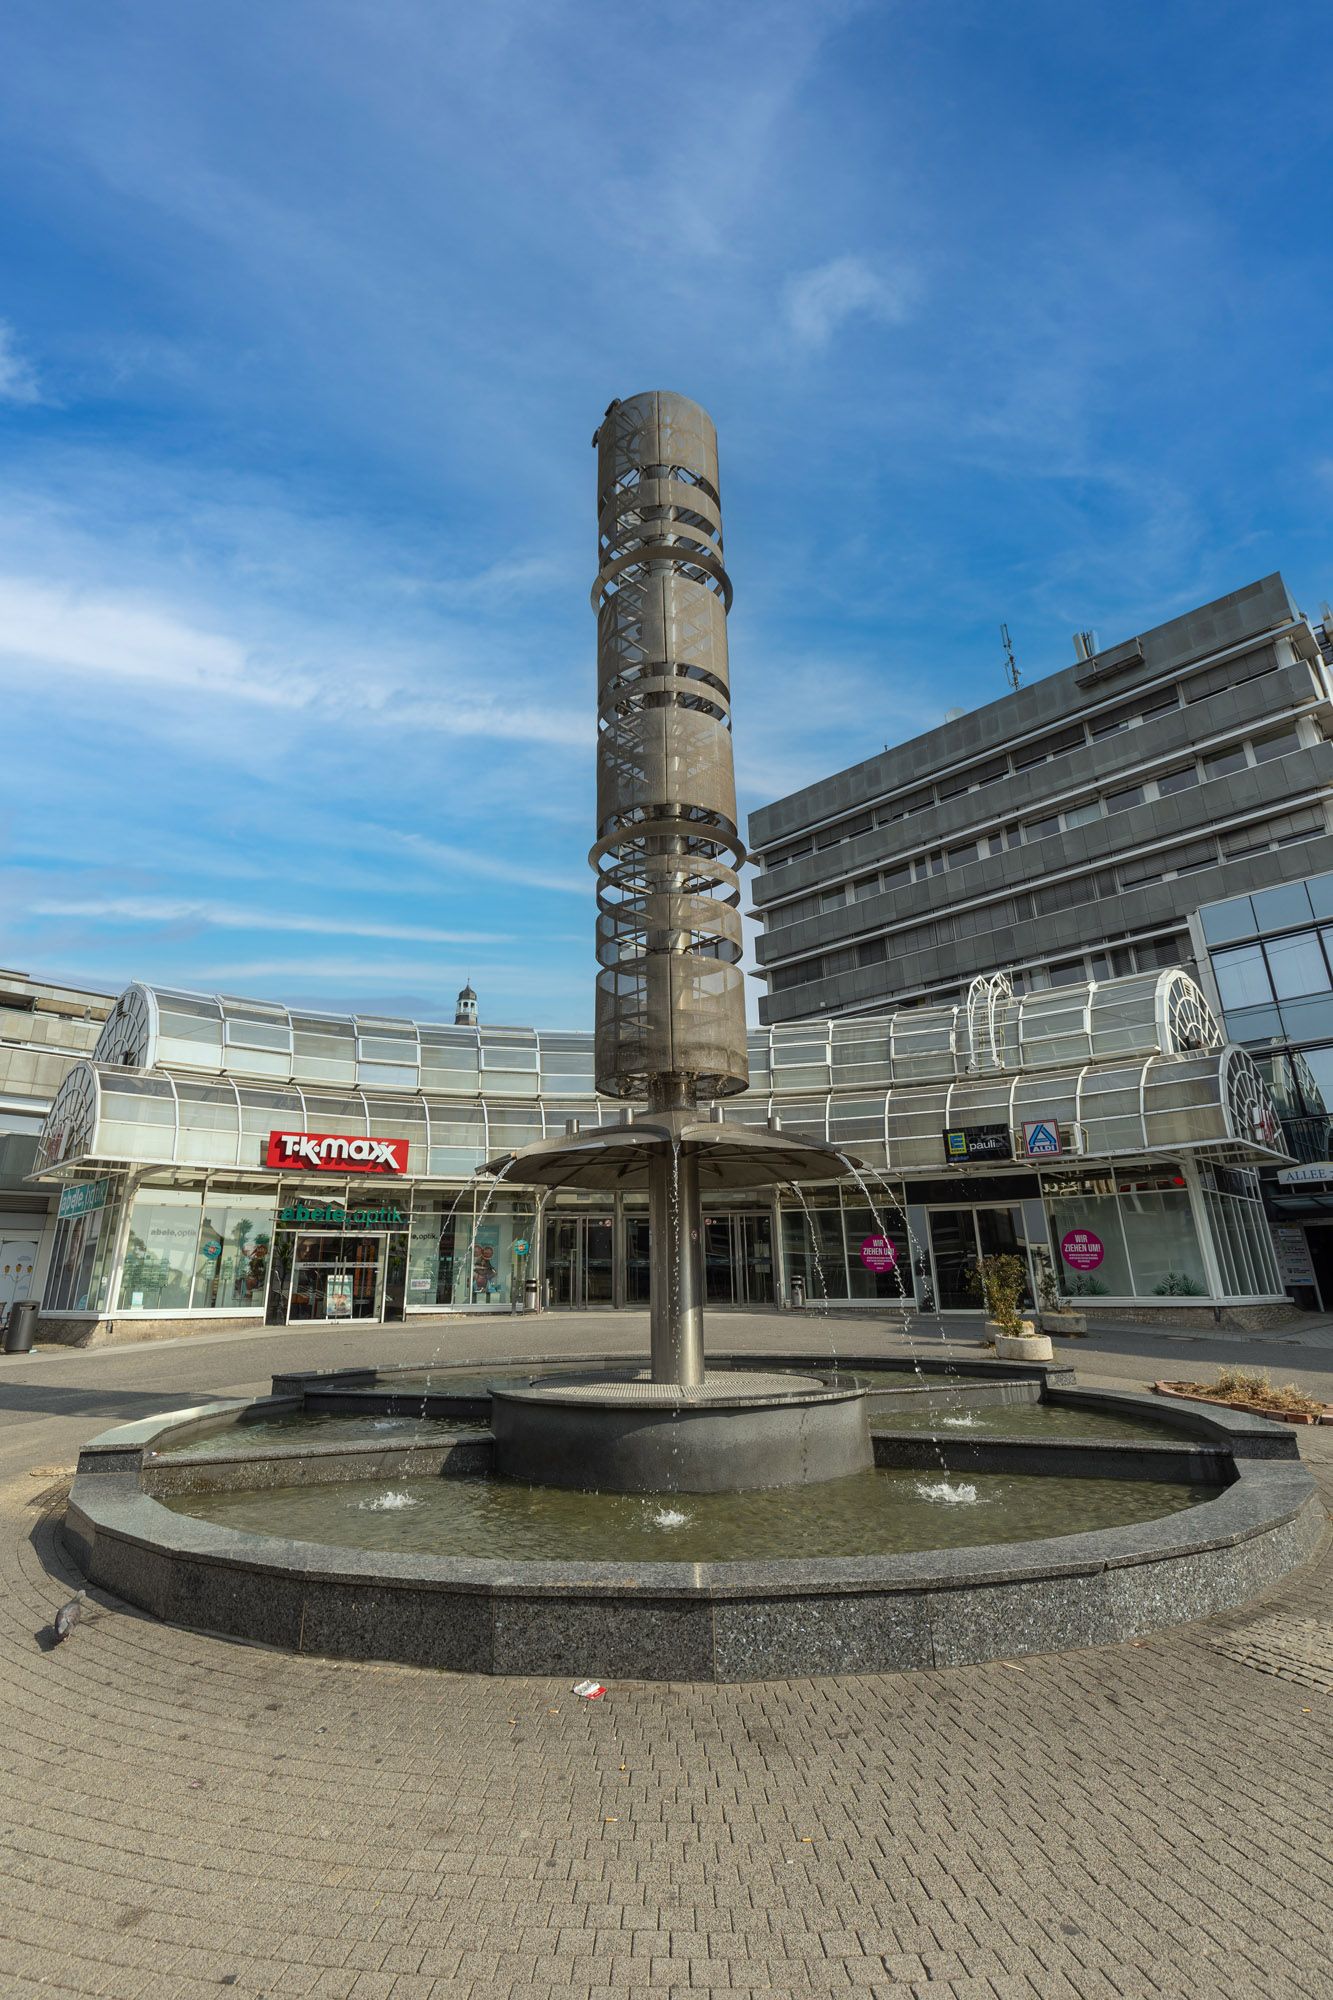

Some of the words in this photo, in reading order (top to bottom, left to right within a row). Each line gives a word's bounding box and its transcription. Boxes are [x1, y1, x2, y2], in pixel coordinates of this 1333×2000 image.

[969, 1139, 996, 1151] pauli
[1287, 1169, 1327, 1181] ALLEE
[1075, 1234, 1088, 1243] WIR
[1064, 1243, 1087, 1252] ZIEHEN
[1088, 1243, 1101, 1252] UM!
